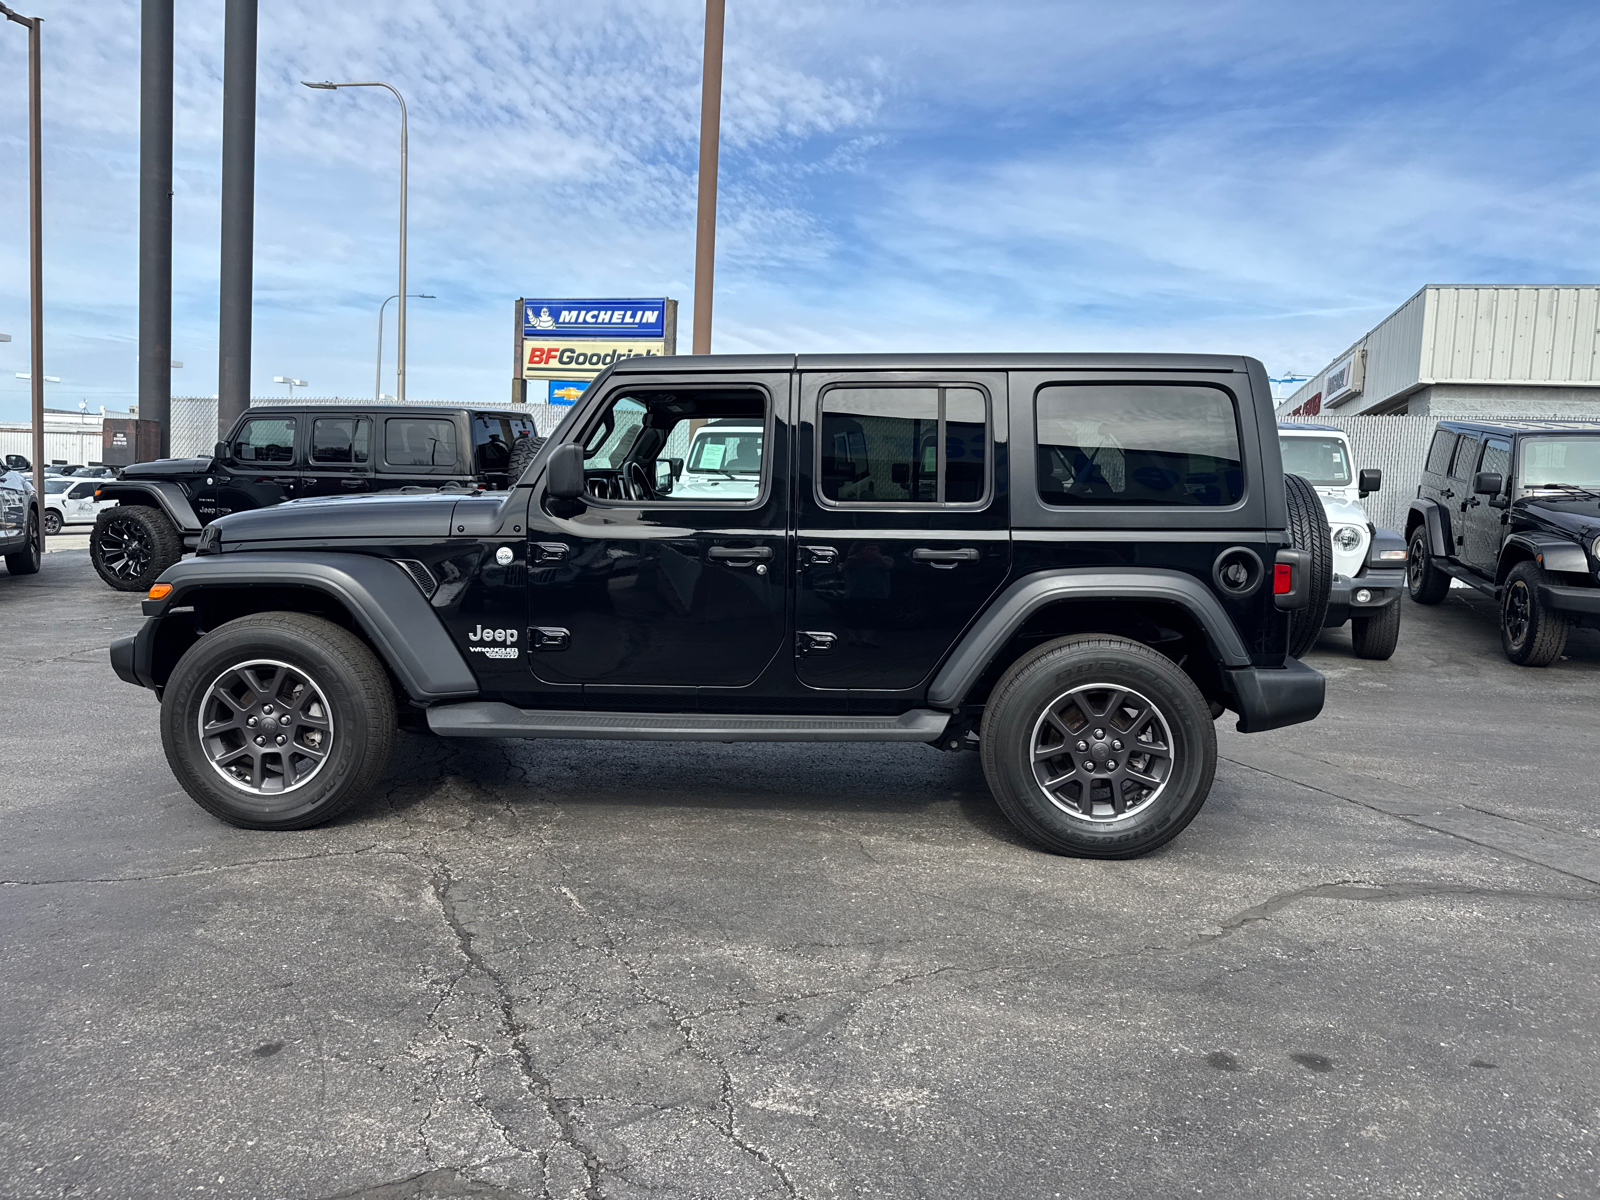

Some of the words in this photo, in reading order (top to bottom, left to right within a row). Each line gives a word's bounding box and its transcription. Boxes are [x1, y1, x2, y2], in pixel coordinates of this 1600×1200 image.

[558, 310, 659, 323] MICHELIN
[528, 347, 658, 366] BFGoodri
[199, 506, 215, 515] Jeep
[468, 624, 518, 645] Jeep
[1054, 660, 1174, 697] DUELER
[1020, 796, 1171, 845] BRIDGESTONE
